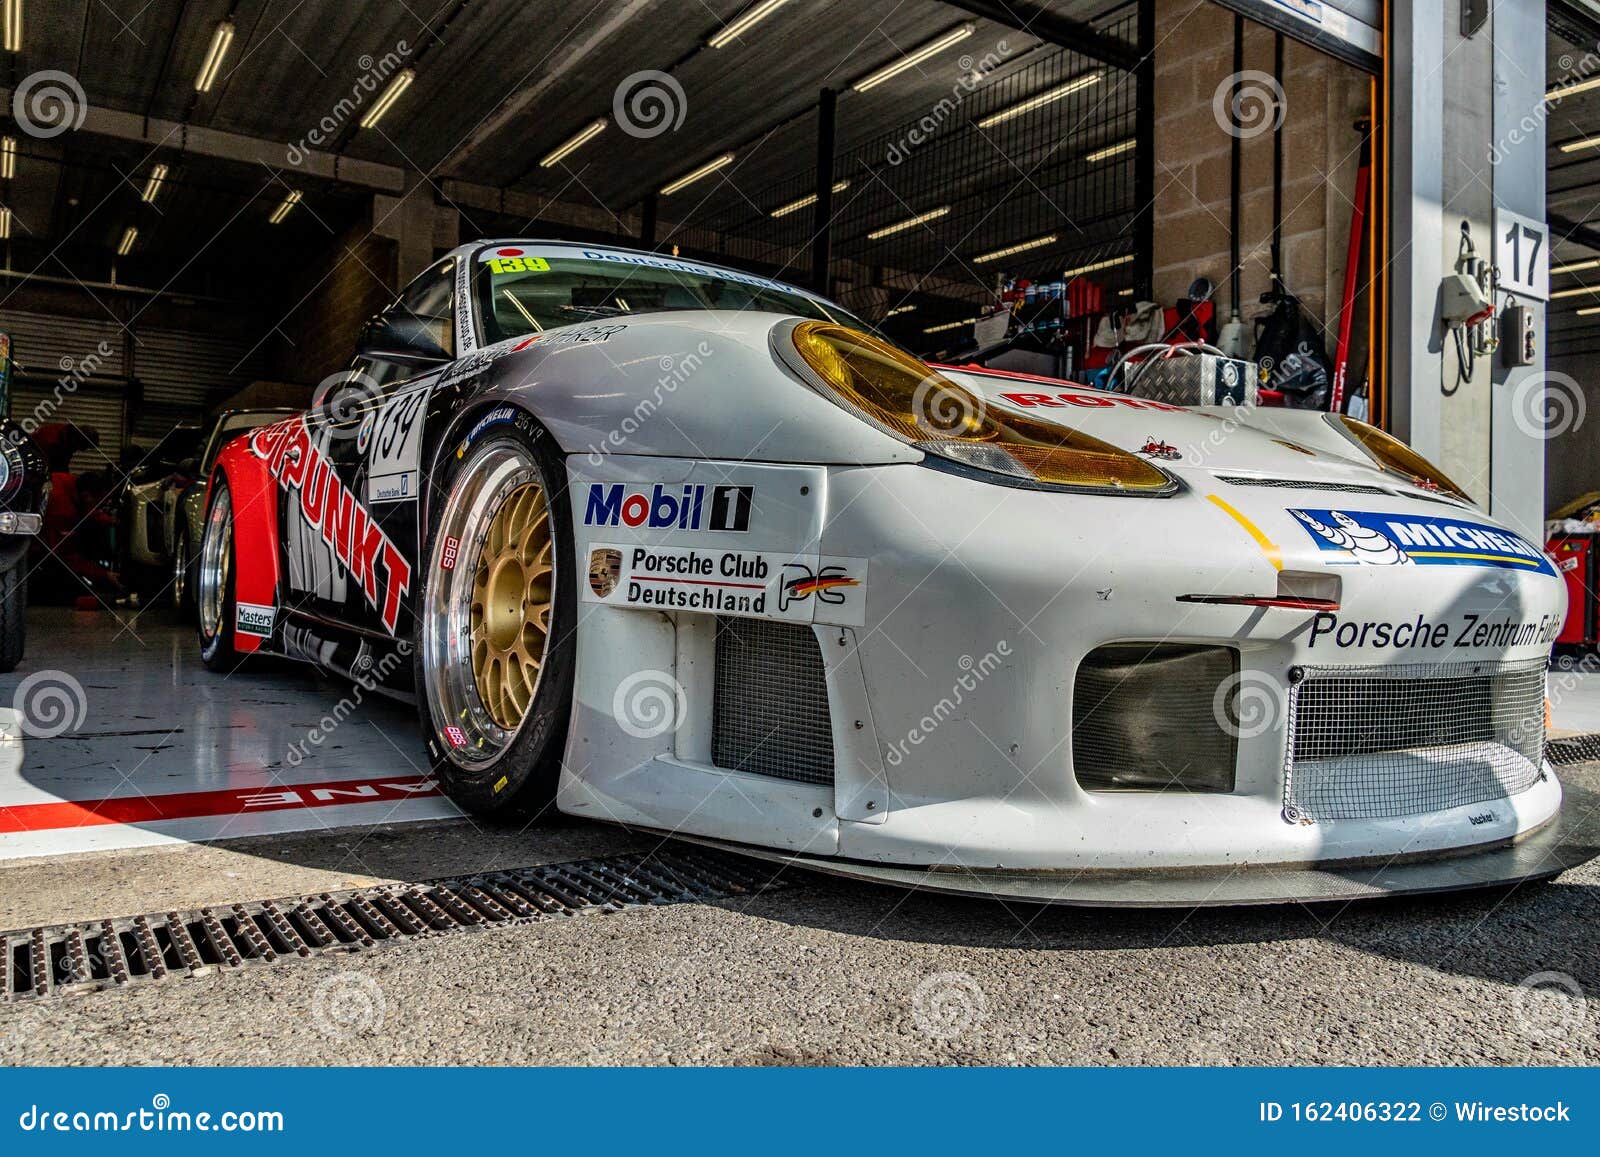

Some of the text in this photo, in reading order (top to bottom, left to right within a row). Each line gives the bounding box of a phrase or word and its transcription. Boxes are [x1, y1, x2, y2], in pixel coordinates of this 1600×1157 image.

[486, 257, 550, 274] 139
[582, 251, 709, 275] Deutsche
[1506, 222, 1543, 287] 17
[372, 389, 428, 466] 139
[584, 483, 705, 530] Mobil
[443, 537, 458, 569] BBS
[1386, 521, 1543, 559] MICHELIN
[631, 548, 769, 579] Porsche Club
[627, 582, 766, 613] Deutschland
[238, 607, 272, 625] Masters
[1308, 612, 1450, 649] Porsche
[1453, 614, 1537, 648] Zentrum
[236, 780, 441, 807] ANE
